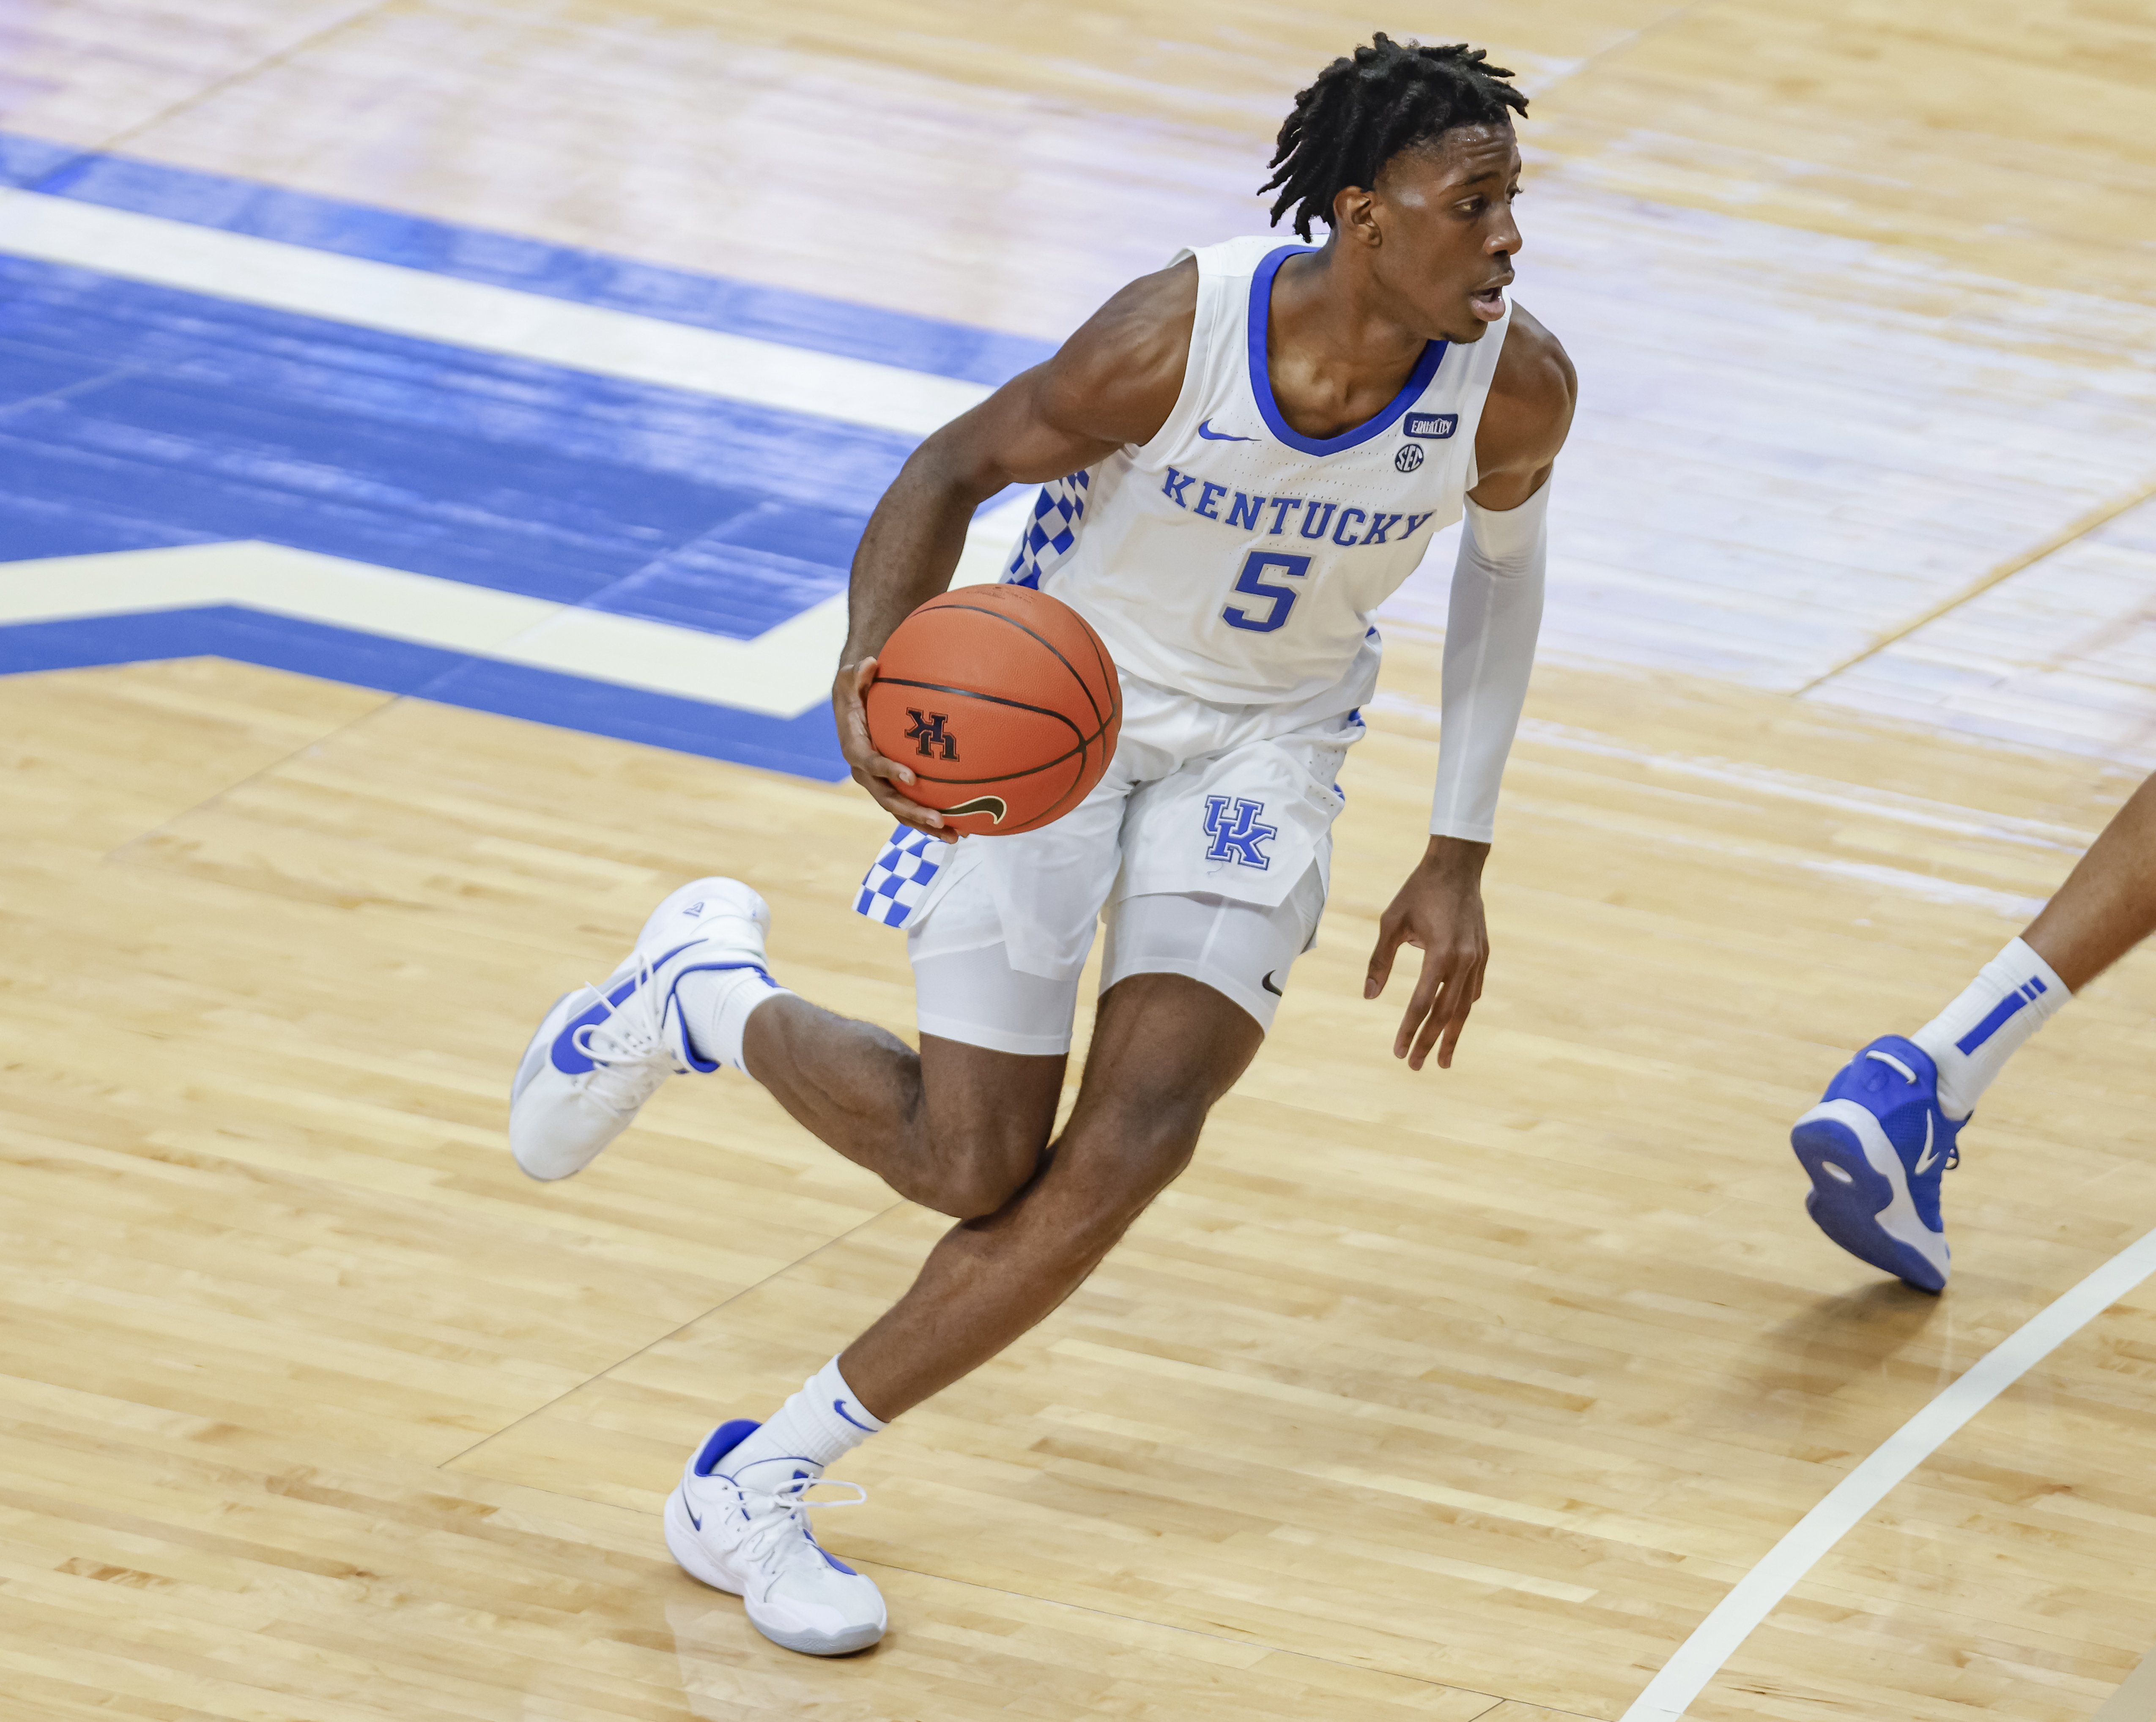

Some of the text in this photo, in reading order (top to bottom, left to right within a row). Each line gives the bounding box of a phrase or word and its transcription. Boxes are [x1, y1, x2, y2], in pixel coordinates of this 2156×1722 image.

[1396, 444, 1422, 471] SEC
[1411, 418, 1452, 435] EQUALITY
[1161, 466, 1436, 547] KENTUCKY
[1221, 550, 1313, 633] 5
[1203, 794, 1278, 870] UK
